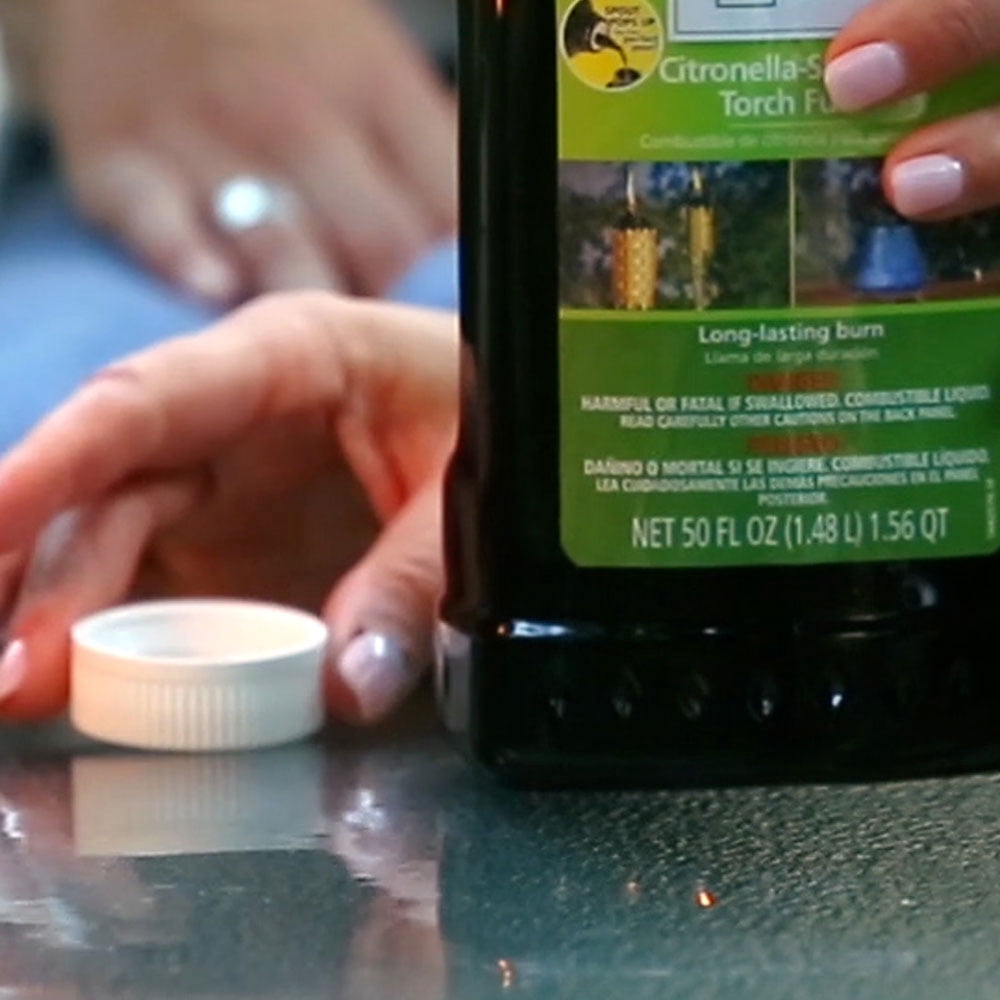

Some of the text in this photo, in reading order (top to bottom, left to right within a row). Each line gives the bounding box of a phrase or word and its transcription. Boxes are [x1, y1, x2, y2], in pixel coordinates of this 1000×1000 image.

[659, 54, 825, 85] Citronella-S
[720, 90, 795, 118] Torch
[699, 320, 885, 347] Long-lasting burn
[580, 395, 652, 412] HARMFUL
[655, 396, 678, 412] OR
[681, 395, 725, 412] FATAL
[727, 394, 742, 410] IF
[844, 388, 941, 408] COMBUSTIBLE
[620, 414, 654, 428] READ
[657, 414, 726, 428] CAREFULLY
[583, 457, 643, 476] DAÑINO
[646, 459, 659, 476] O
[662, 459, 723, 475] MORTAL
[727, 458, 742, 475] SI
[745, 458, 764, 475] SE
[595, 478, 620, 492] LEA
[742, 477, 766, 491] LAS
[632, 516, 676, 549] NET
[682, 516, 711, 548] 50
[716, 516, 741, 547] FL
[746, 514, 779, 546] OZ
[785, 512, 839, 549] (1.48
[843, 510, 863, 547] L)
[870, 509, 916, 542] 1.56
[920, 506, 949, 544] QT
